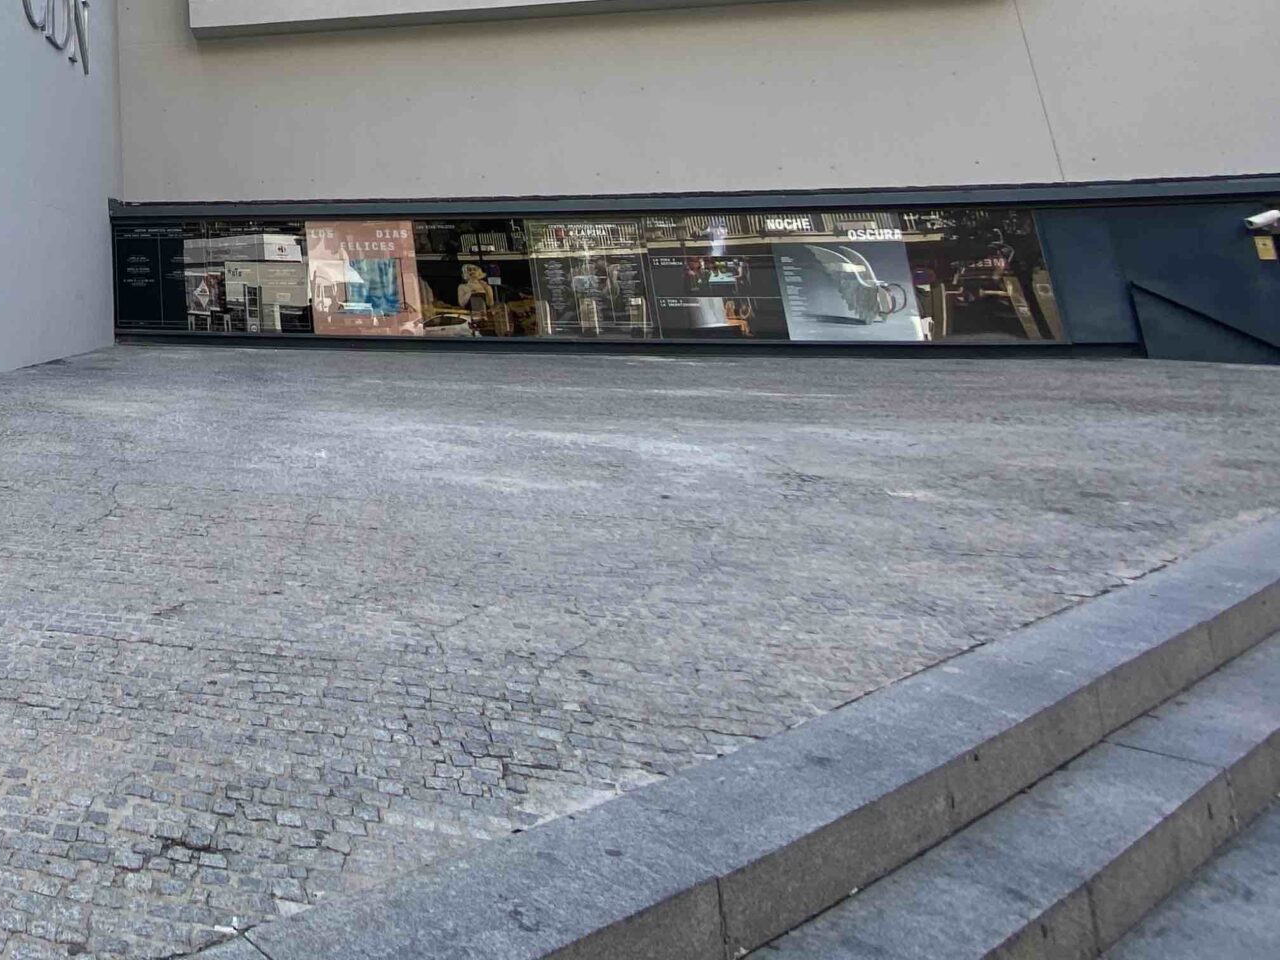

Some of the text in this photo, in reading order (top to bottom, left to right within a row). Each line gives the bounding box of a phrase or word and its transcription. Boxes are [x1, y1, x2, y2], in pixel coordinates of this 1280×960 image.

[766, 218, 812, 231] NOCHE
[311, 228, 335, 239] LOS
[847, 228, 903, 241] OSCURA
[340, 241, 396, 252] FELICES
